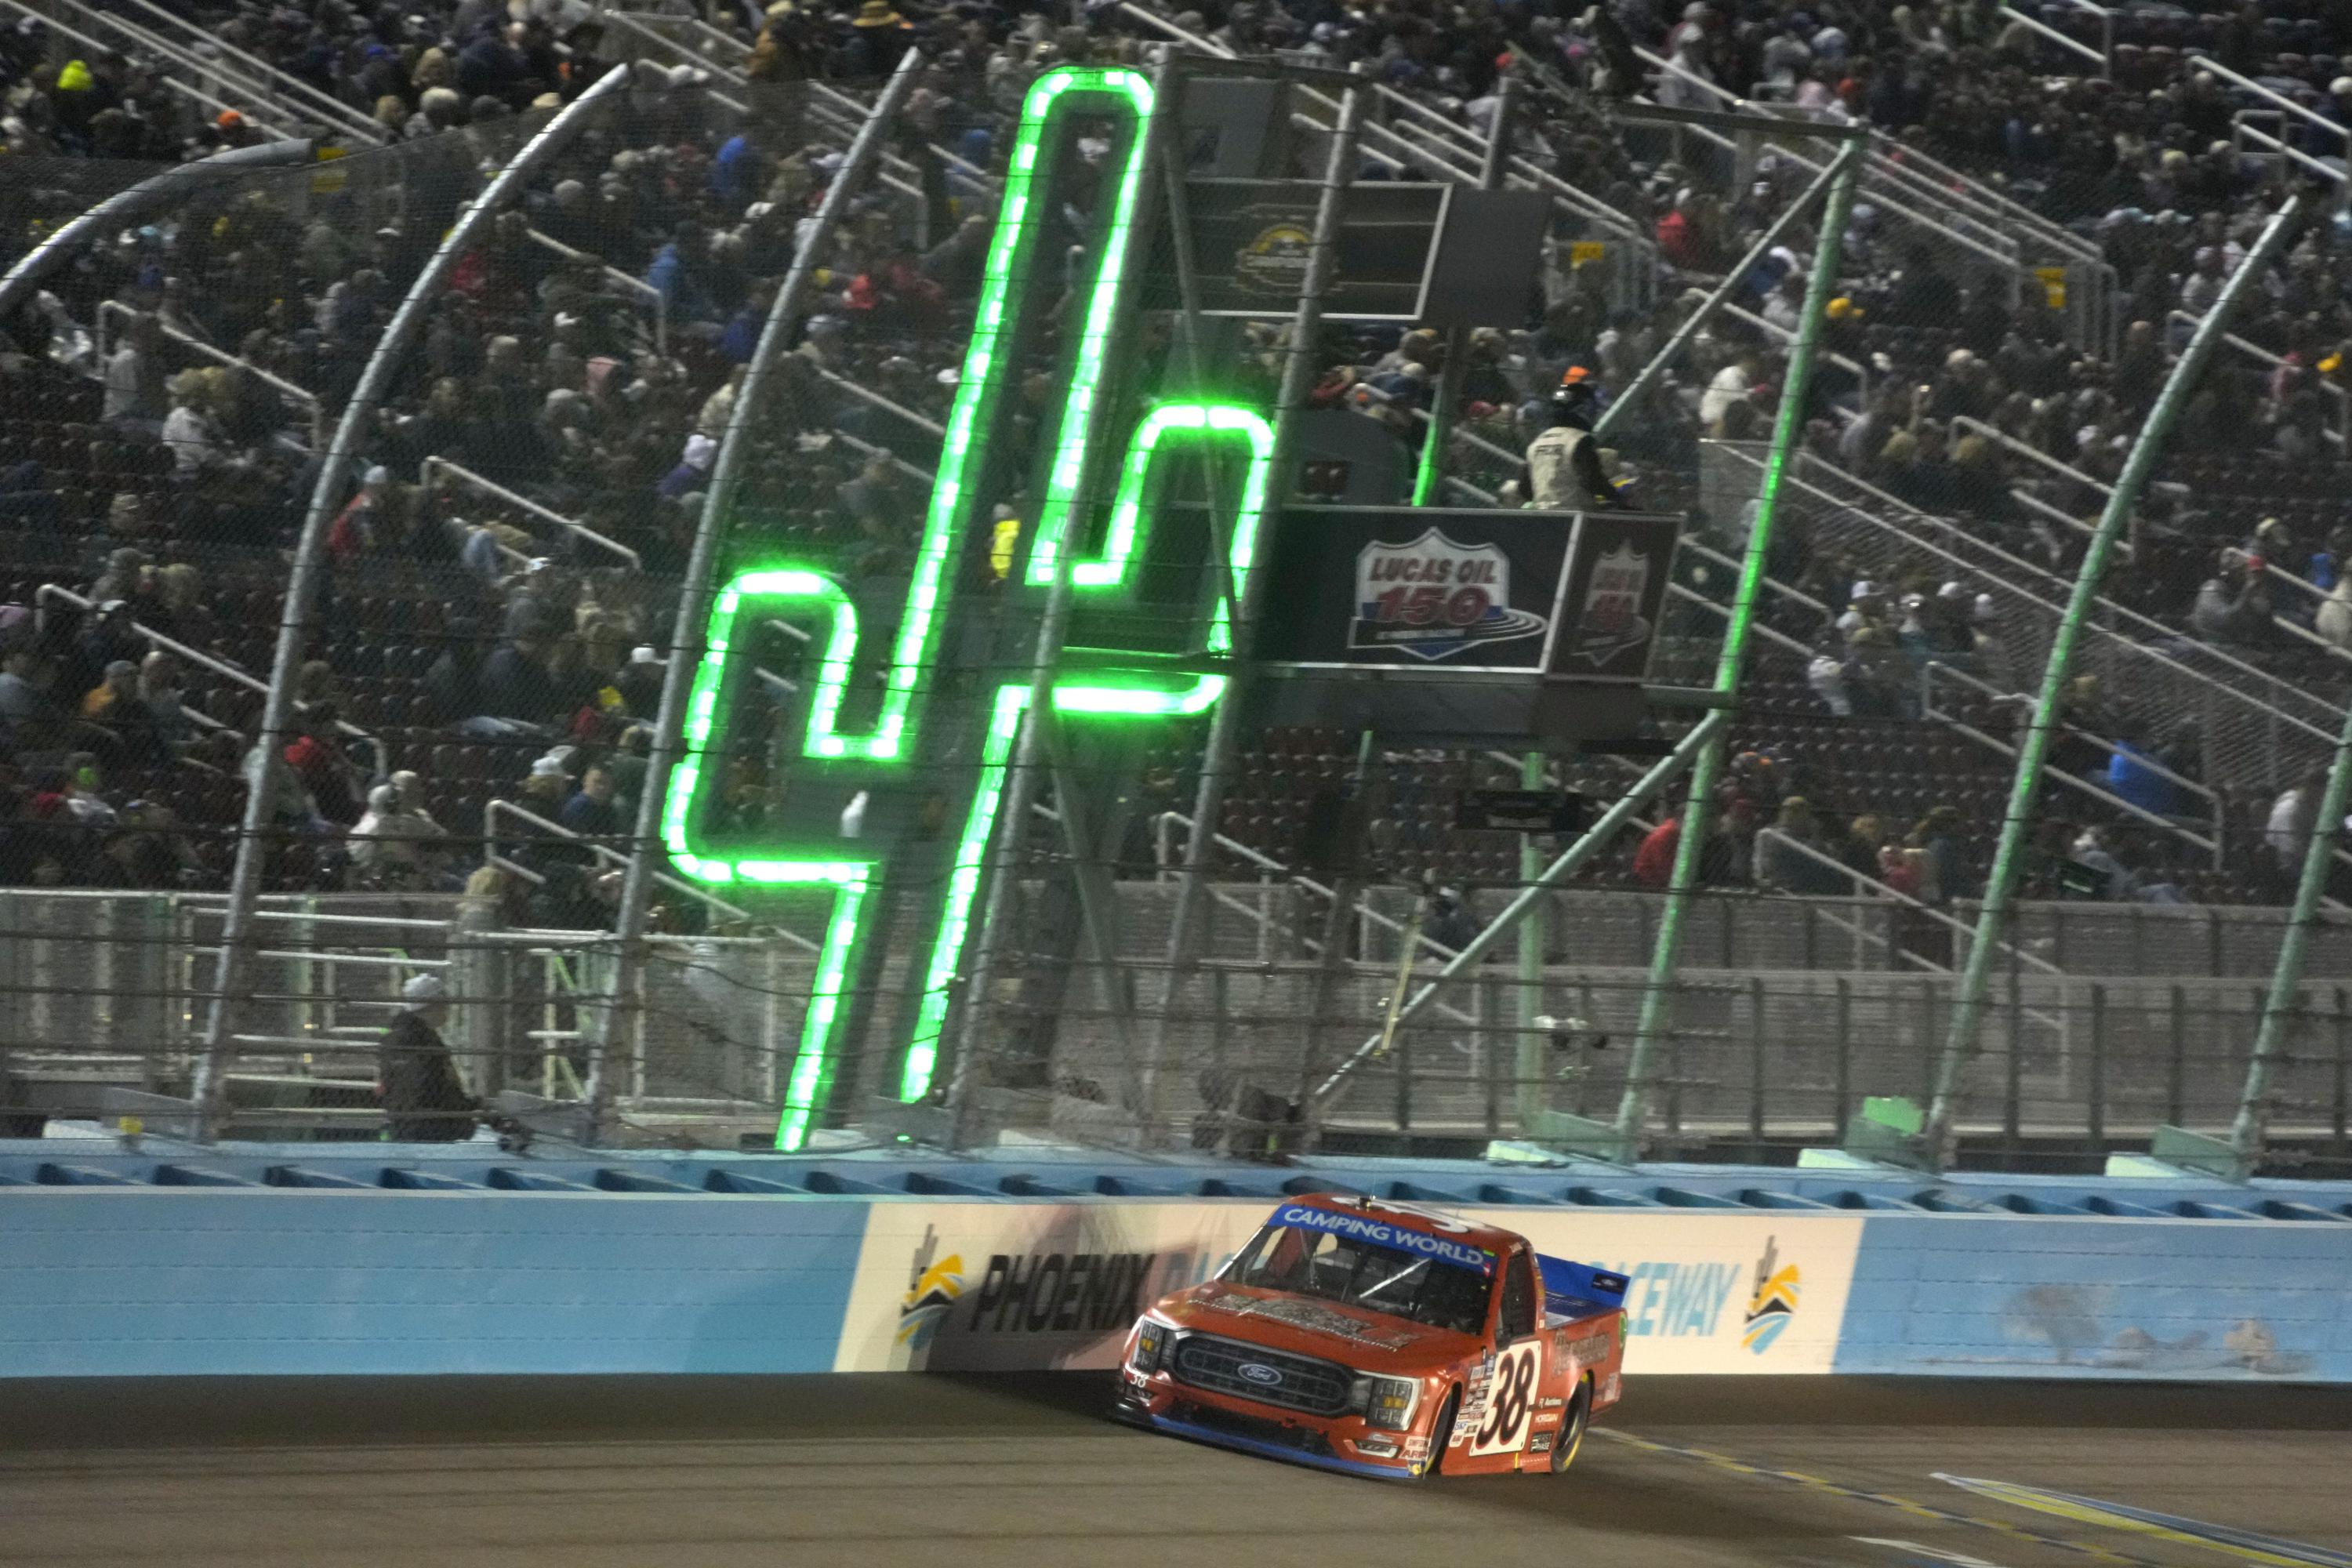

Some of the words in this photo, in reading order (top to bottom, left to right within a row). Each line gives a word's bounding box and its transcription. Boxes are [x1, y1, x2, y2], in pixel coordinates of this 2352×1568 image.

[1369, 557, 1453, 583] LUCAS
[1457, 559, 1496, 584] OIL
[1376, 585, 1490, 626] 150
[1284, 1208, 1391, 1240] CAMPING
[1396, 1230, 1483, 1265] WORLD
[969, 1254, 1156, 1333] PHOENIX
[1589, 1261, 1741, 1336] CEWAY
[1475, 1348, 1535, 1450] 38
